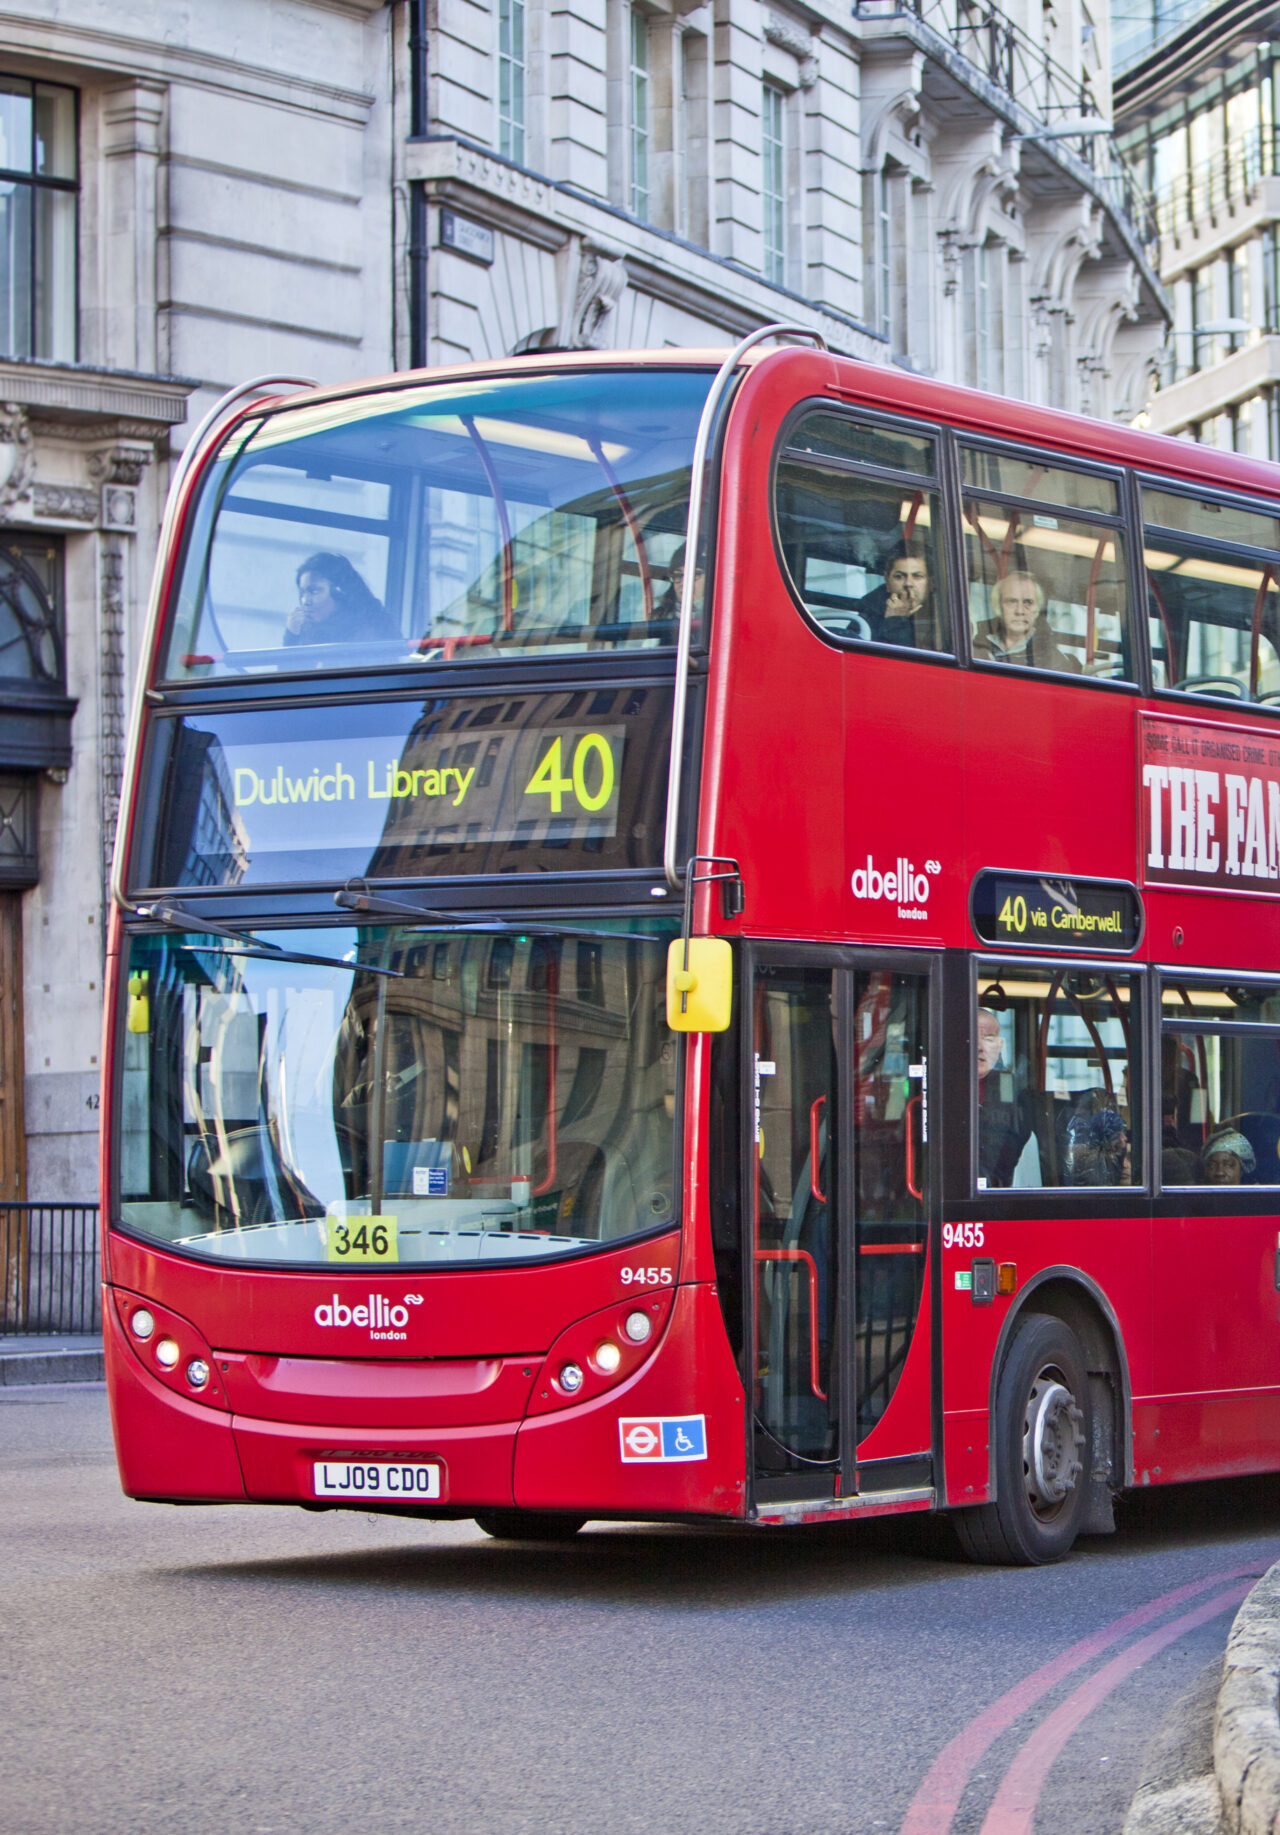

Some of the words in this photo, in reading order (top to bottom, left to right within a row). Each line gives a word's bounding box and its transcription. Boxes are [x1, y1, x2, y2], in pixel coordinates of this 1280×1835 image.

[1146, 732, 1169, 753] SOME
[1171, 736, 1190, 755] CALL
[1191, 738, 1199, 757] IT
[1201, 739, 1240, 762] ORGANISED
[234, 762, 355, 807] Dulwich
[367, 758, 476, 808] Library
[525, 732, 615, 813] 40
[1143, 764, 1220, 873] THE
[851, 854, 930, 904] abellio
[897, 906, 929, 920] london
[998, 895, 1028, 933] 40
[1031, 907, 1047, 927] via
[1051, 905, 1123, 933] Camberwell
[335, 1225, 389, 1255] 346
[943, 1222, 985, 1249] 9455
[620, 1267, 673, 1285] 9455
[314, 1293, 409, 1329] abellio
[370, 1330, 407, 1340] london
[323, 1464, 380, 1490] LJ09
[387, 1467, 429, 1492] CDO
